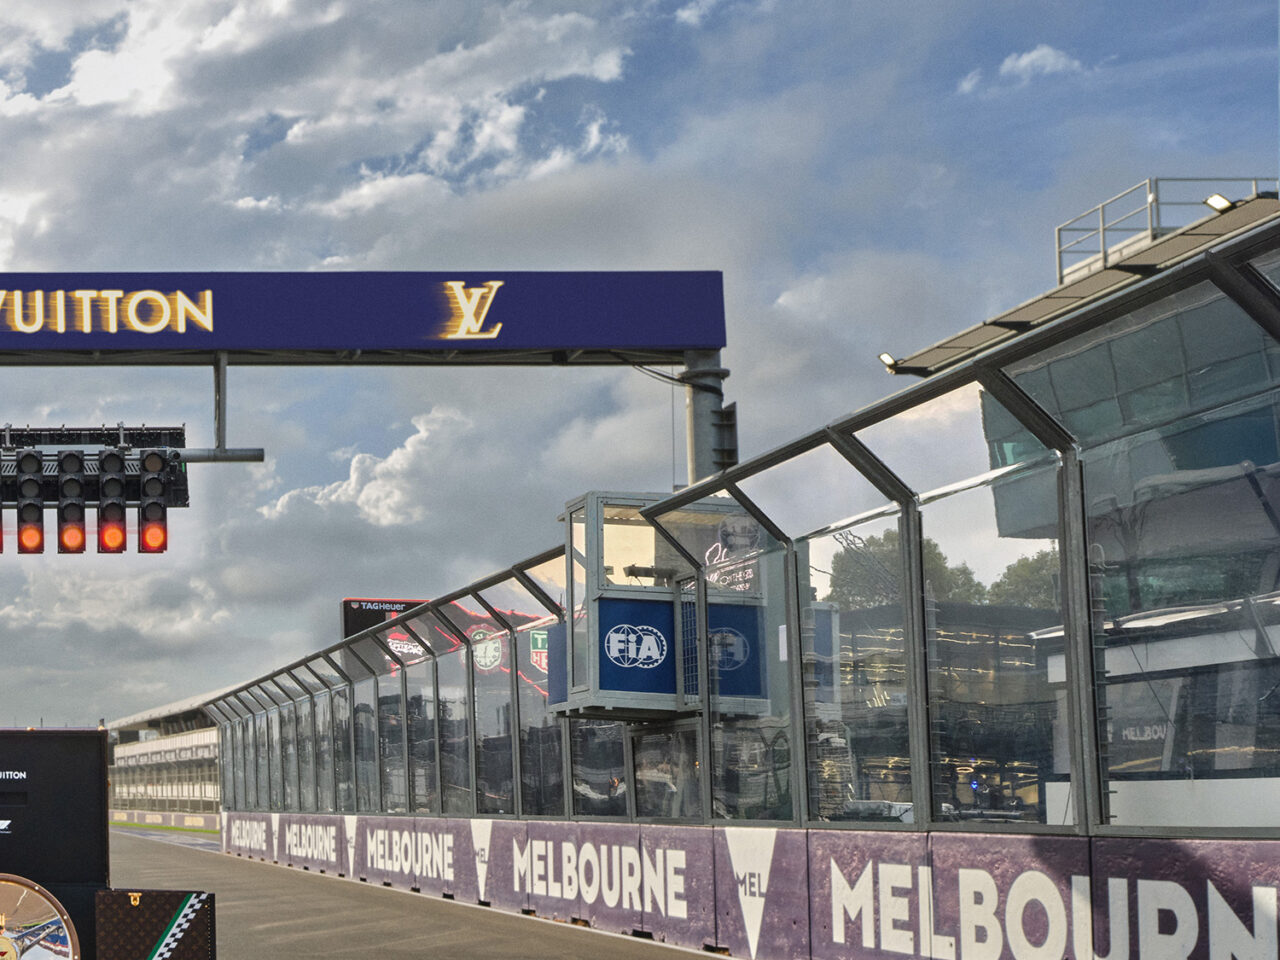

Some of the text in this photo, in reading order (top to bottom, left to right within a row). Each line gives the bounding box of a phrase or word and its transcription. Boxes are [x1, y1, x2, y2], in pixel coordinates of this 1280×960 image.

[285, 823, 337, 862] MELBOURNE
[367, 828, 454, 881] MELBOURNE
[513, 837, 687, 919] MELBOURNE
[736, 871, 766, 898] MEL
